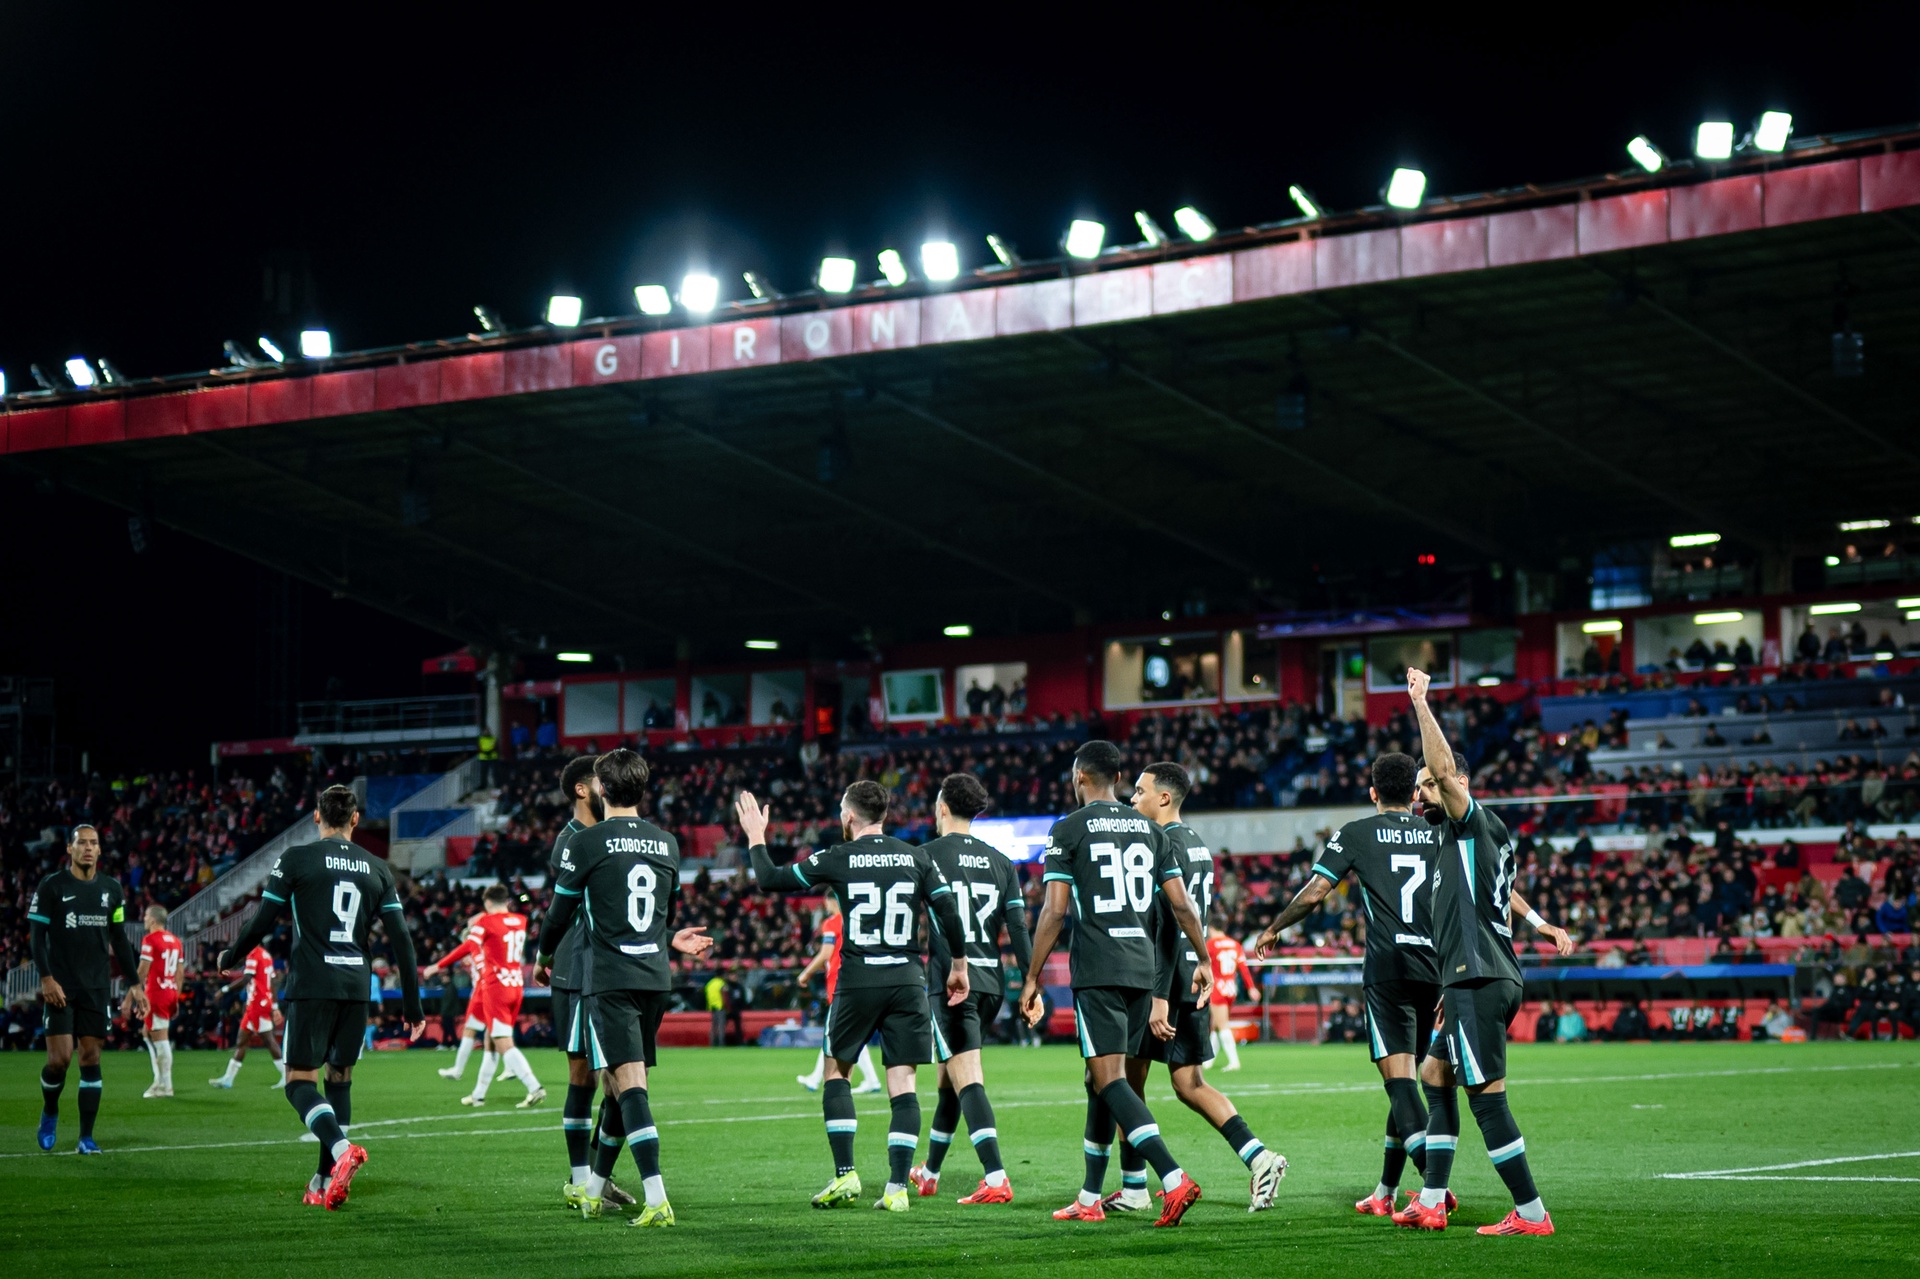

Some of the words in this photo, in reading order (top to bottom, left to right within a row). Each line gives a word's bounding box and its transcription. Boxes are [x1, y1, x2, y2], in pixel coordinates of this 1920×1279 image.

[595, 298, 972, 376] GIRONA
[325, 856, 370, 875] DARWIN
[606, 838, 668, 856] SZOBOSZLAI
[1376, 829, 1402, 844] LUIS
[1404, 828, 1434, 844] DÍAZ
[627, 864, 656, 932] 8
[1090, 842, 1154, 913] 38
[1391, 854, 1426, 923] 7
[329, 881, 361, 942] 9
[848, 882, 915, 946] 26
[952, 881, 1000, 943] 17
[161, 948, 179, 977] 14
[503, 930, 526, 963] 18
